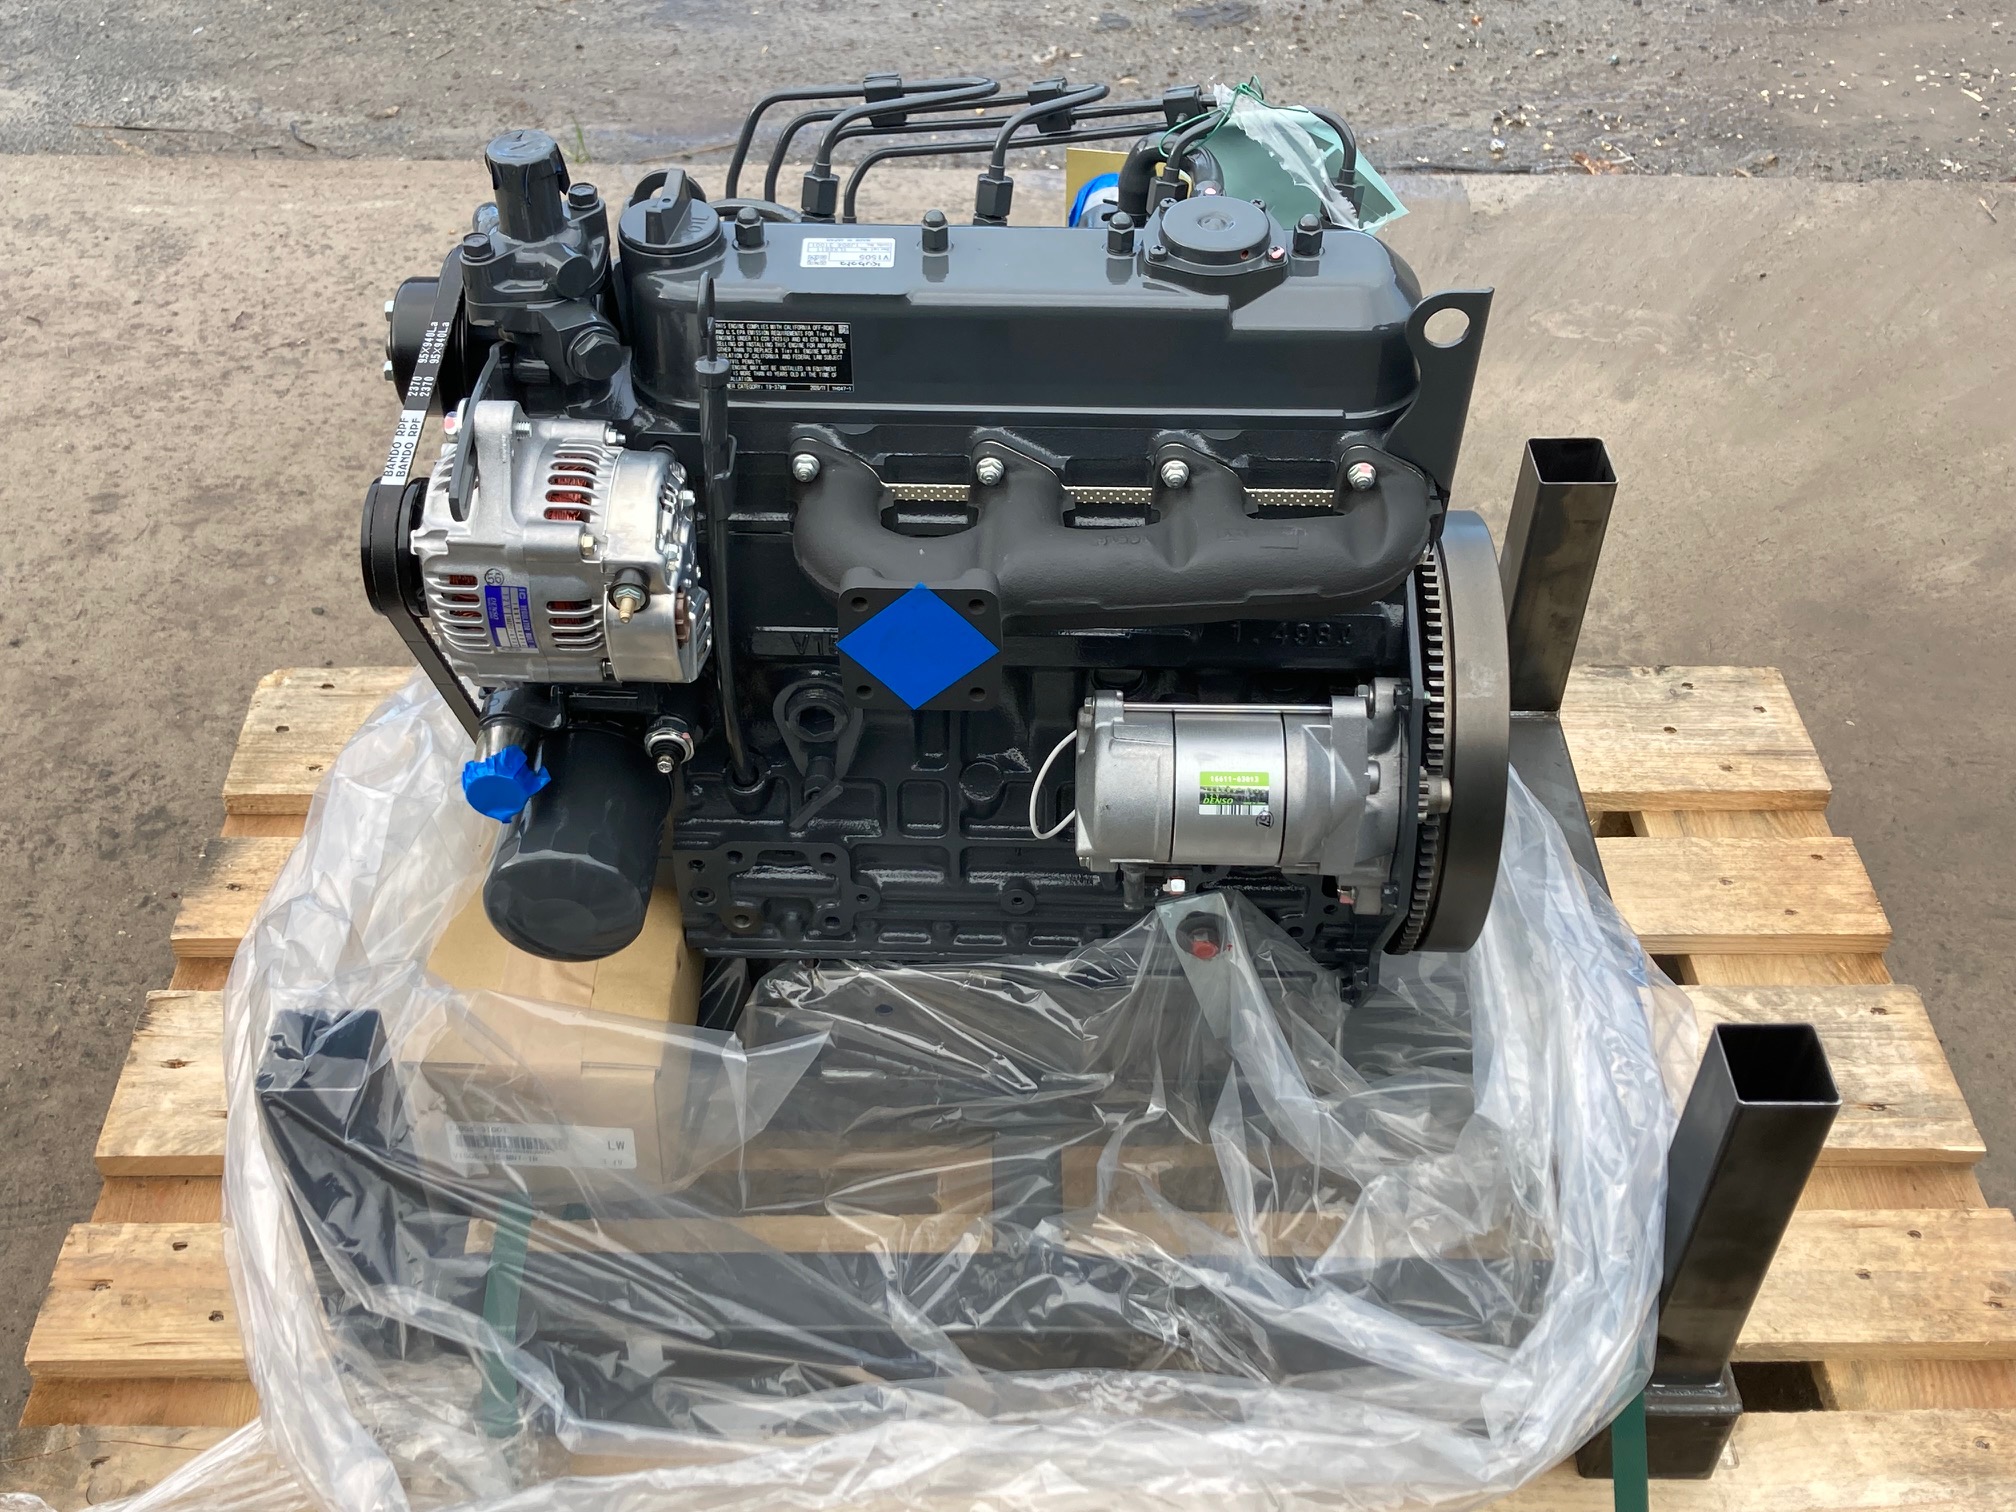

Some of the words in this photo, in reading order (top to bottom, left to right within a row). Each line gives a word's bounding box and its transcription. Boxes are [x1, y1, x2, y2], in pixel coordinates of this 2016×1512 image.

[687, 215, 709, 232] OIL
[384, 441, 402, 477] BANDO
[395, 417, 409, 436] RPF
[407, 376, 422, 397] 2370
[395, 442, 414, 477] BANDO
[408, 418, 421, 437] RPF
[419, 376, 434, 397] 2370
[518, 588, 526, 600] IC
[607, 1141, 625, 1151] LW
